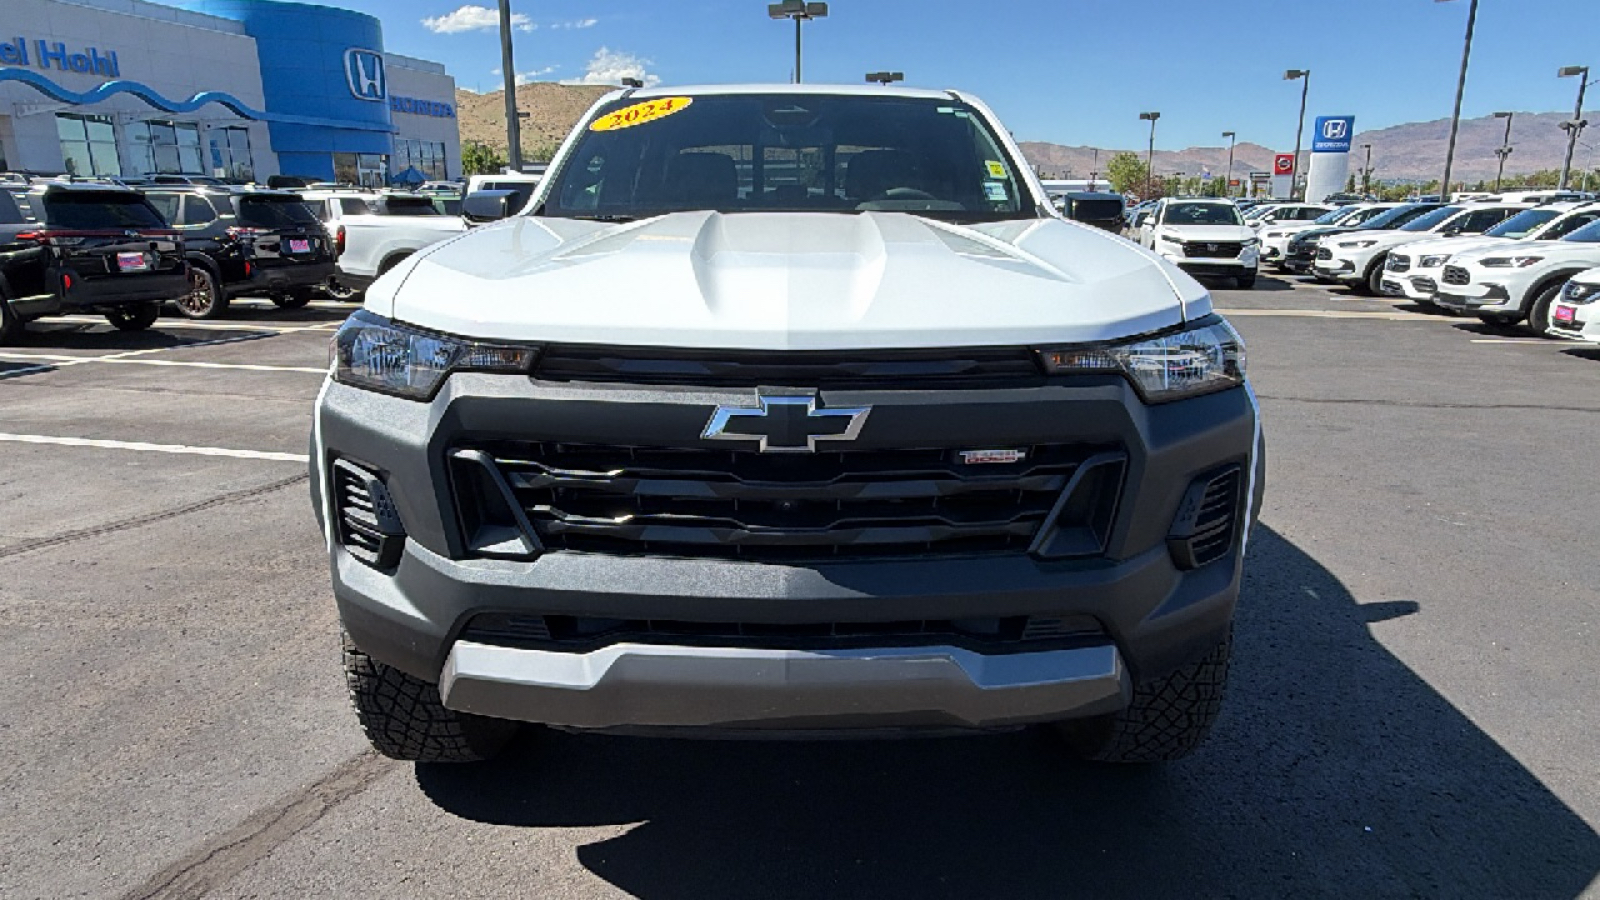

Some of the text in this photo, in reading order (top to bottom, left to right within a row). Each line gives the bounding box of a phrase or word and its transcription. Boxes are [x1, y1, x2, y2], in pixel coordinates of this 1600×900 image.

[36, 40, 120, 77] Hohl
[390, 96, 456, 118] HONDA
[610, 100, 673, 127] 2024
